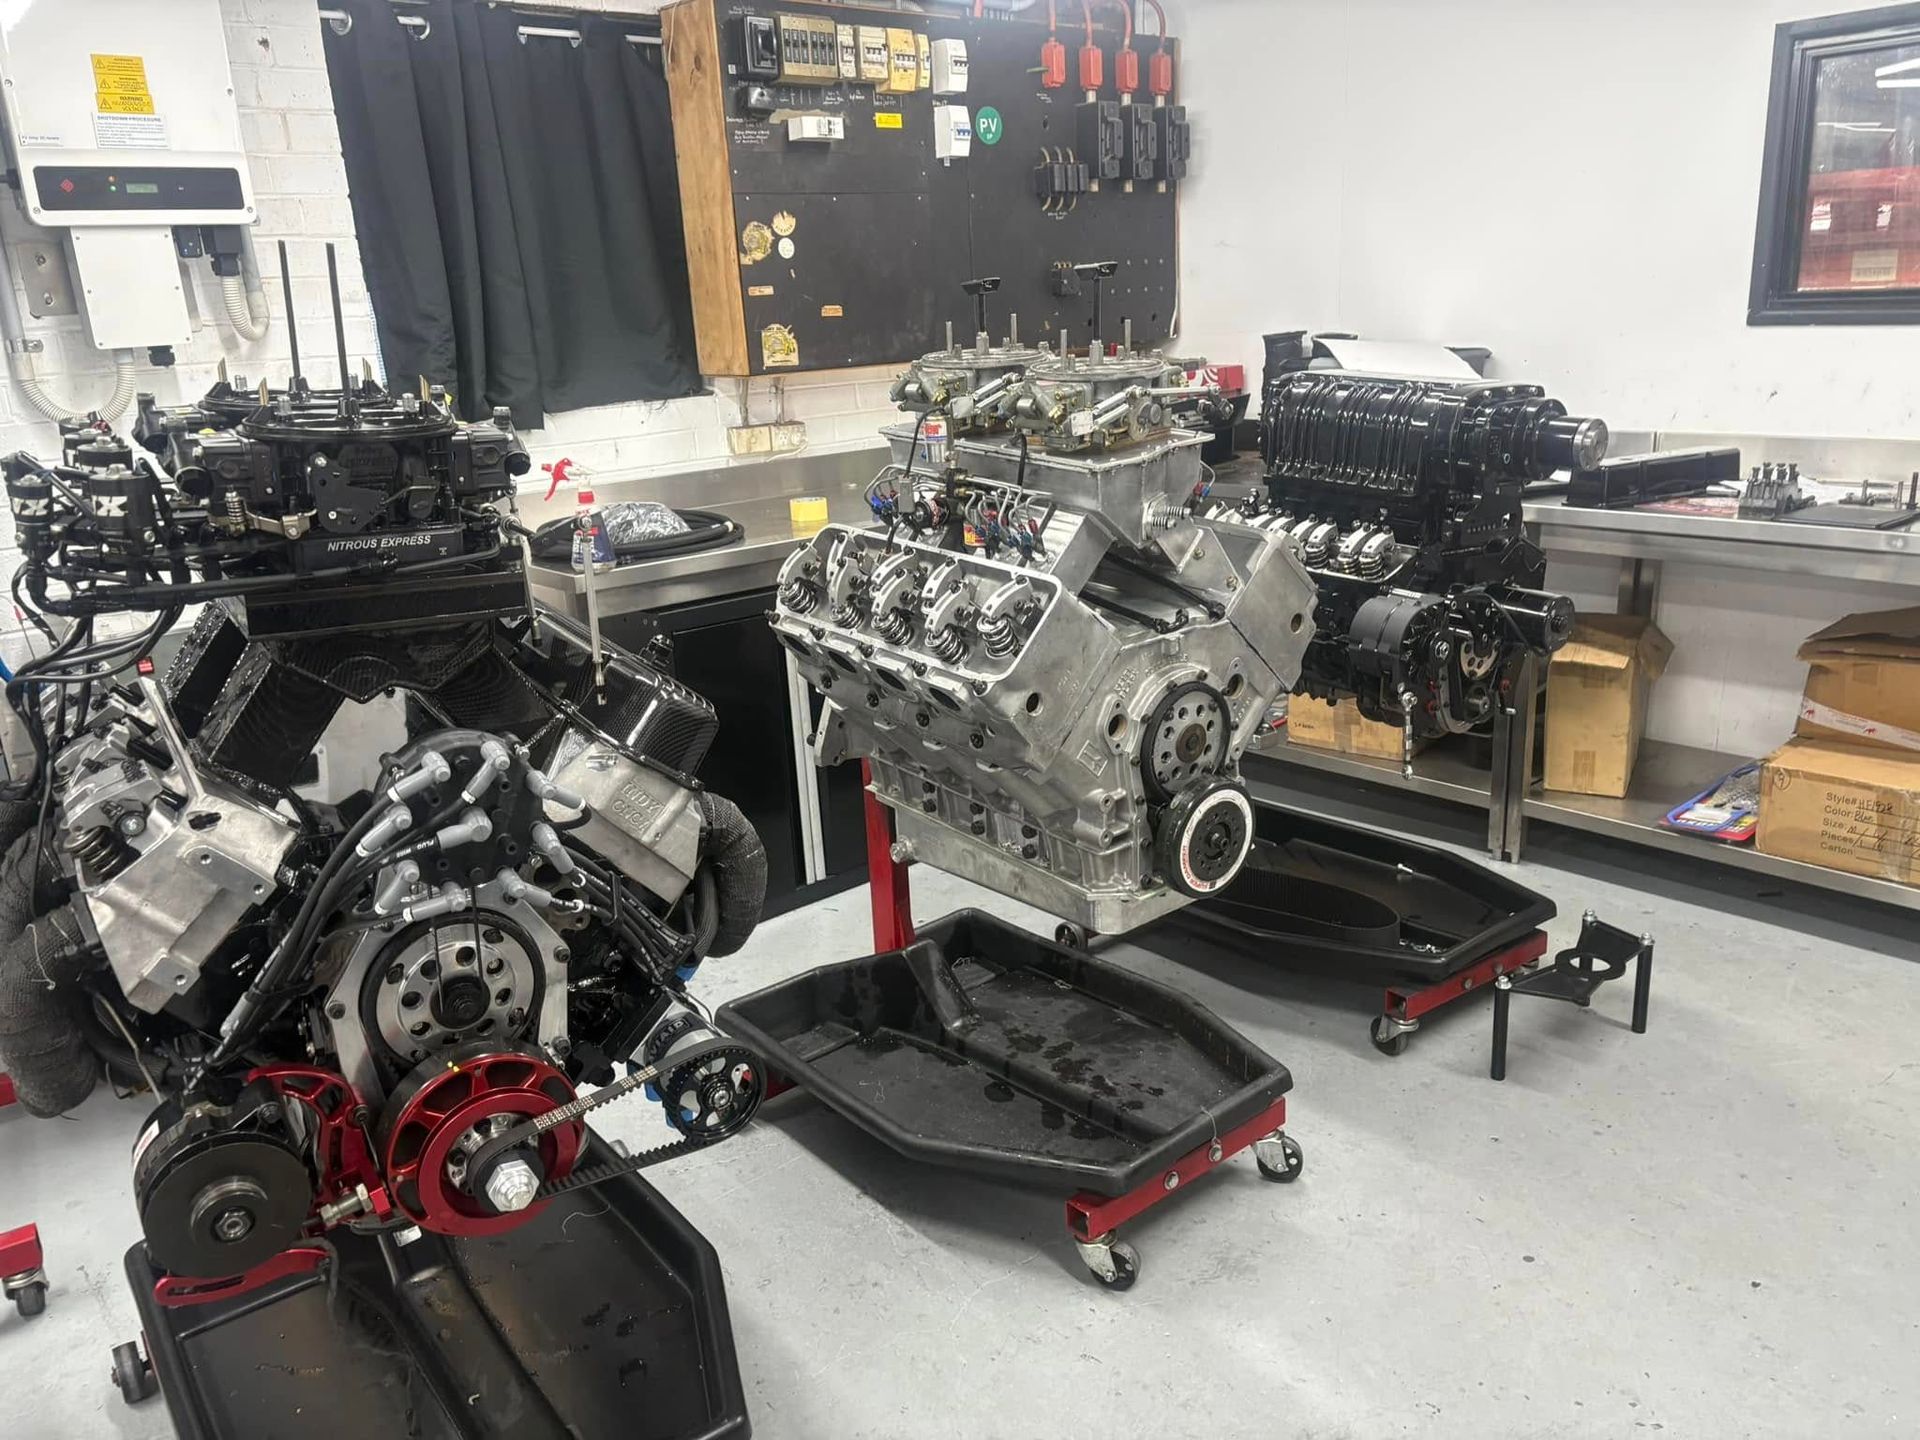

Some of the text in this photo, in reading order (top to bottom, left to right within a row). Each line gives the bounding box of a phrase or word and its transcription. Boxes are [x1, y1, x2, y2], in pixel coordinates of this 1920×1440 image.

[979, 117, 998, 133] PV
[327, 534, 432, 552] NITROUS EXPRESS
[1825, 791, 1857, 806] Style#
[1823, 804, 1854, 818] Color:
